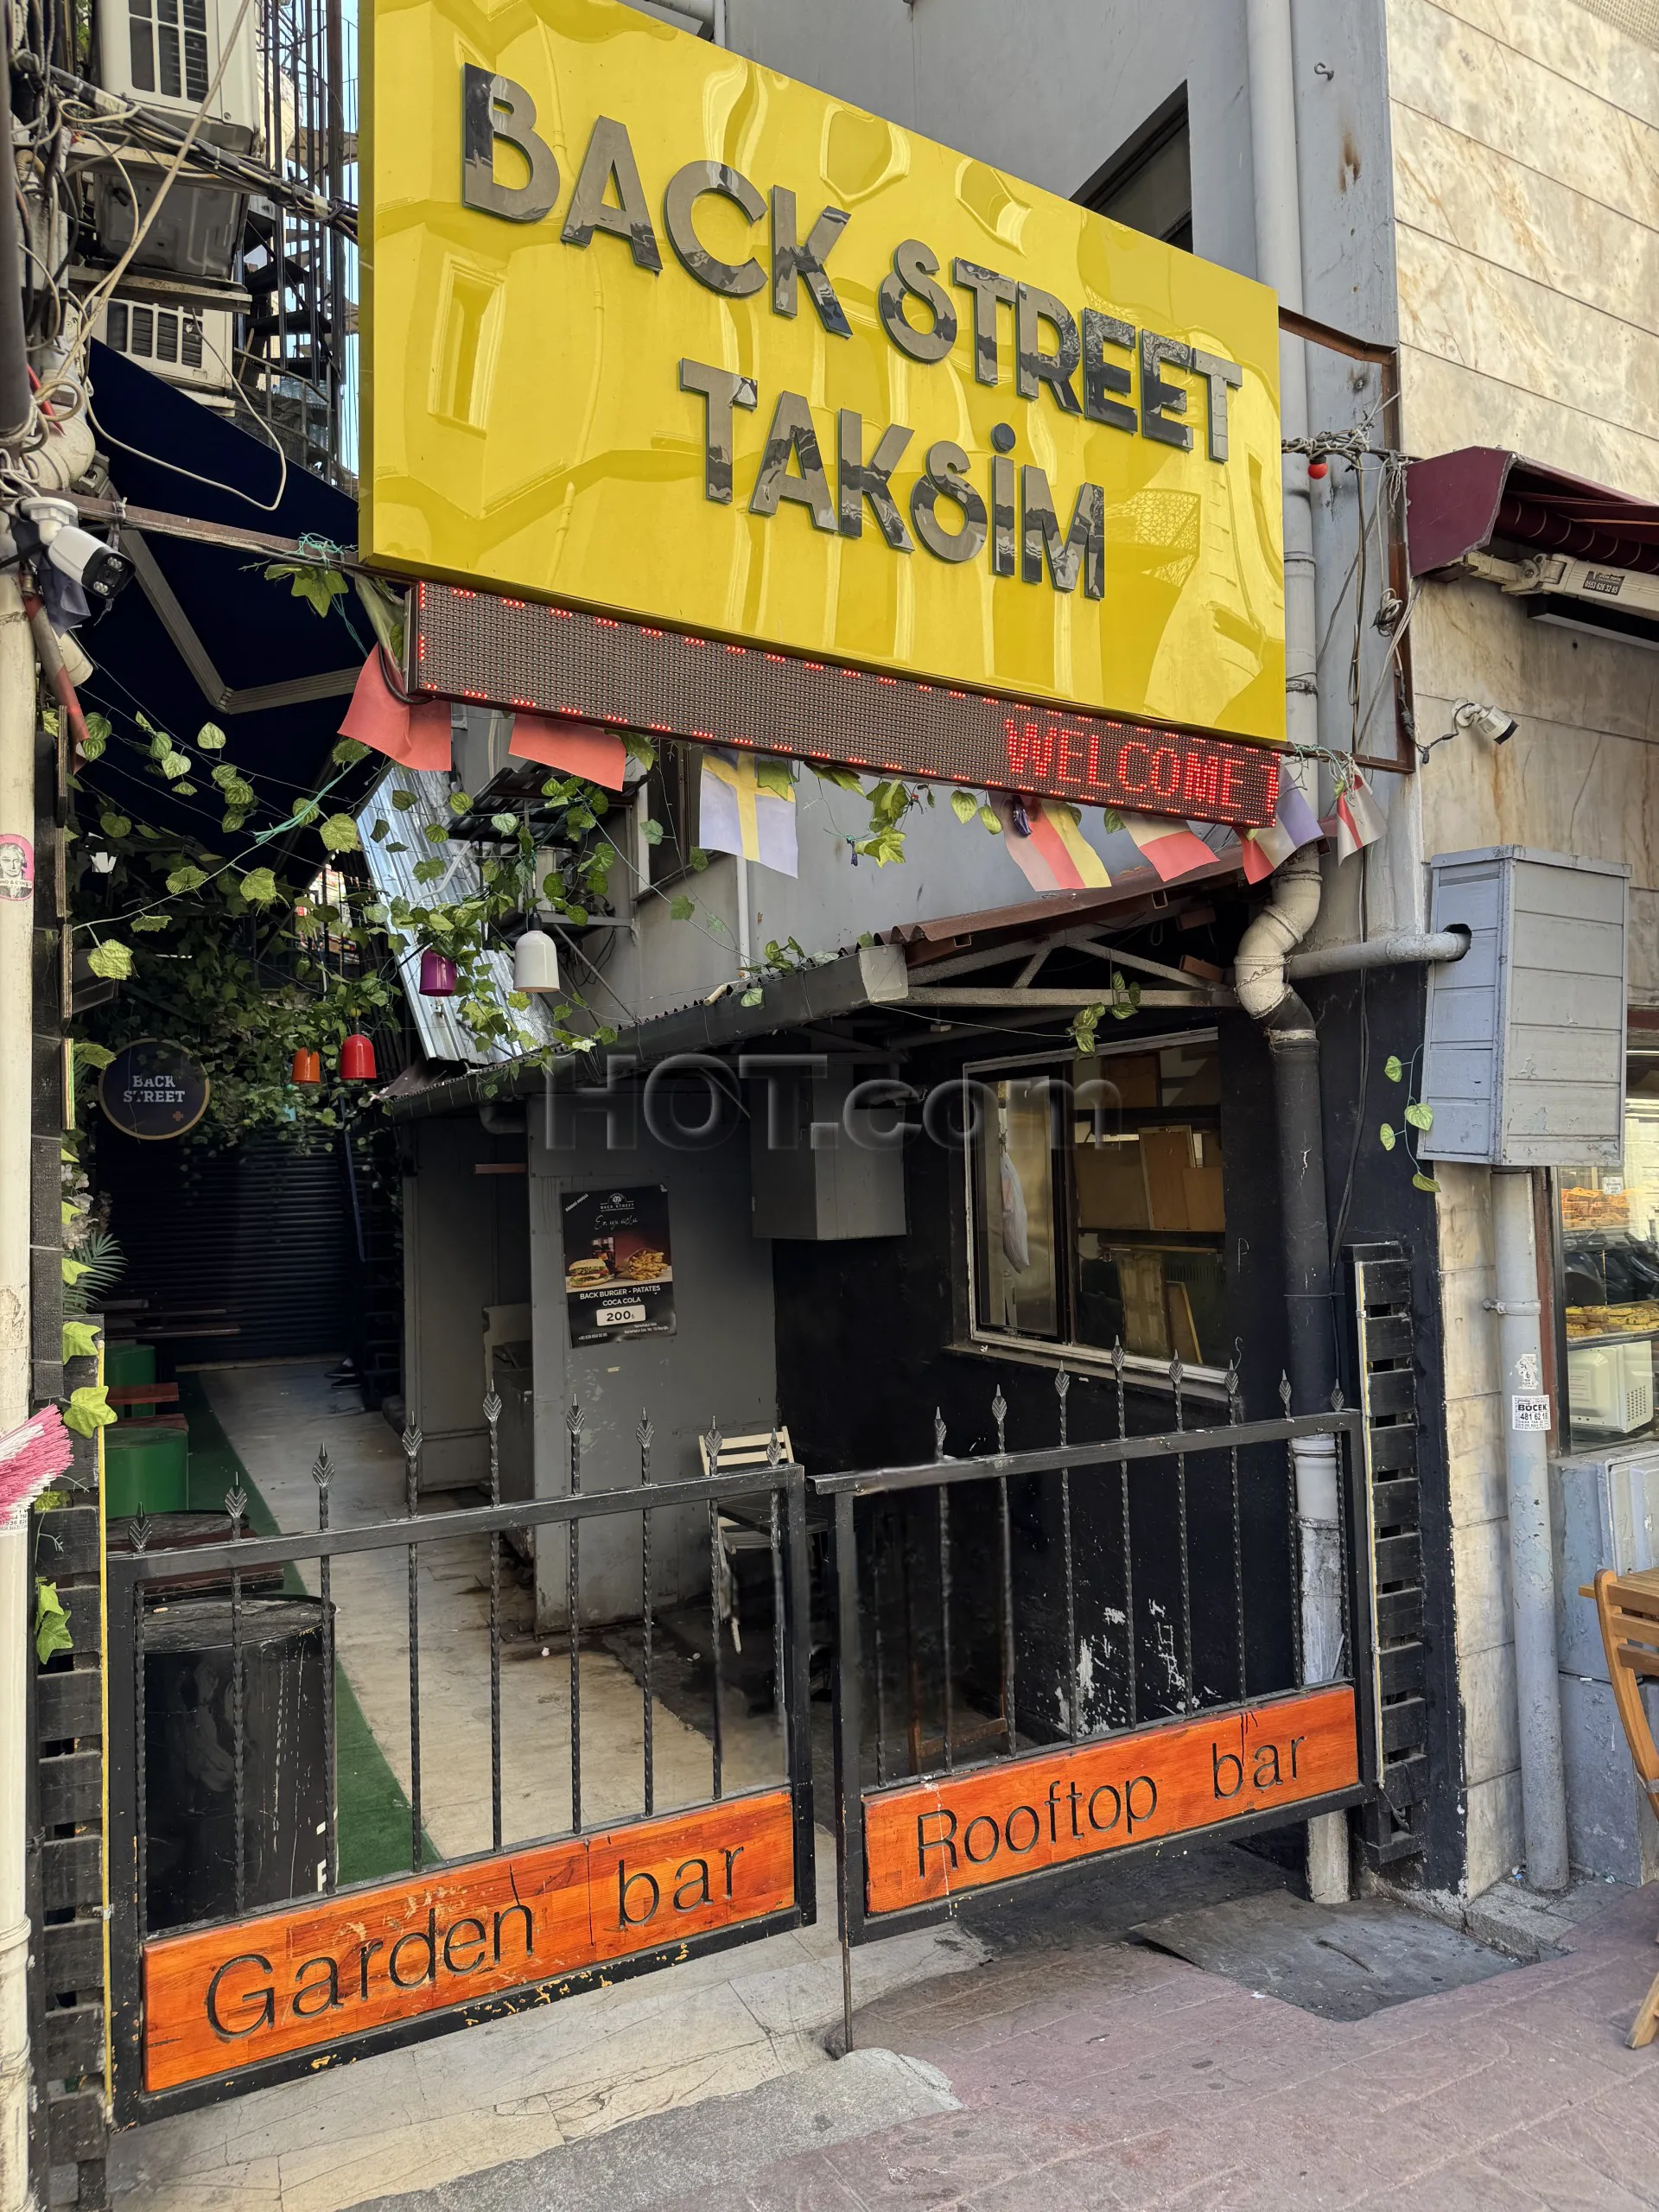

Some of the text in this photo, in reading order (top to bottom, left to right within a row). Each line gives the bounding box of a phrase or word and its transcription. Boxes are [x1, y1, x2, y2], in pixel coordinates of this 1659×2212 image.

[461, 61, 1243, 463] BACK STREET
[1005, 718, 1246, 809] WELCOME
[580, 1292, 599, 1300] BACK
[600, 1288, 627, 1299] BURGER
[632, 1285, 661, 1294] PATATES
[622, 1296, 641, 1305] COLA
[918, 1734, 1306, 1878] Rooftop bar
[205, 1845, 745, 2040] Garden bar
